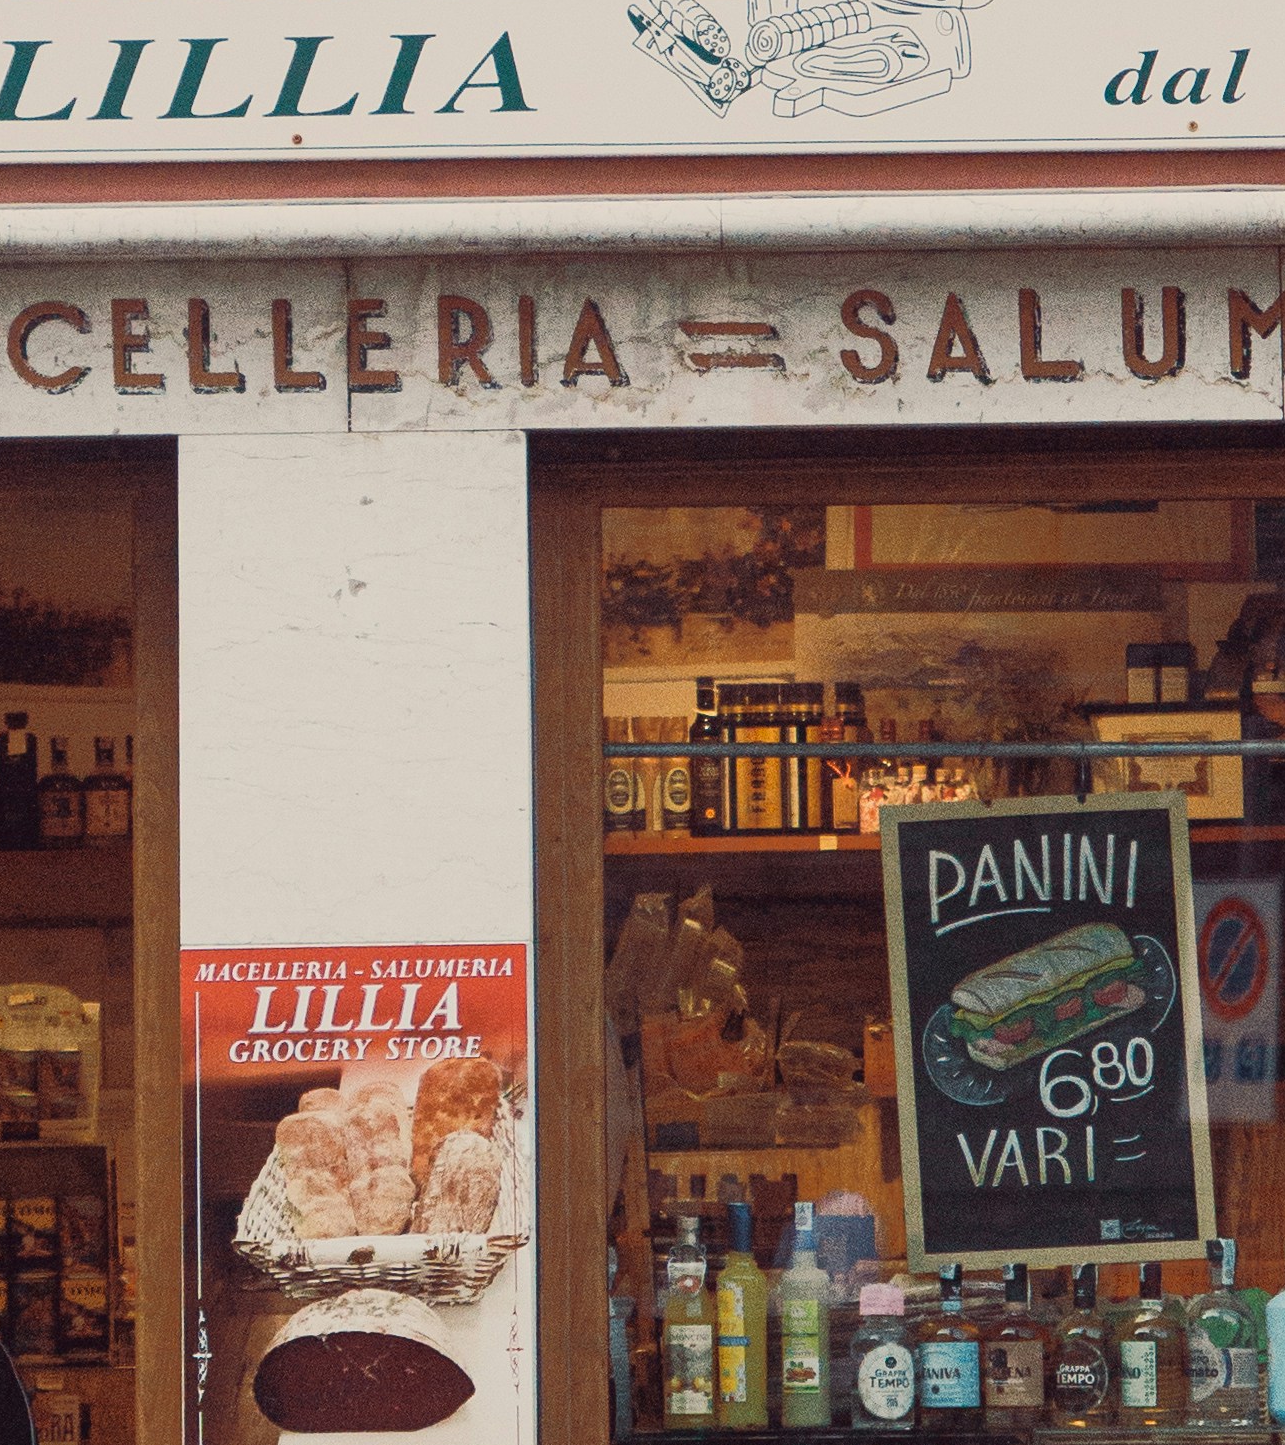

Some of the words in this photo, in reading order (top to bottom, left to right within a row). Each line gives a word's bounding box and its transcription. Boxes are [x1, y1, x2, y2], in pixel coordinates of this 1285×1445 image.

[1104, 47, 1251, 106] dal
[928, 833, 1139, 924] PANINI
[194, 961, 348, 982] MACELLERIA
[370, 957, 513, 980] SALUMERIA
[247, 981, 464, 1035] LILLIA
[229, 1037, 373, 1063] GROCERY
[385, 1035, 483, 1061] STORE
[957, 1125, 1097, 1189] VARI
[869, 1376, 910, 1389] TEMPO
